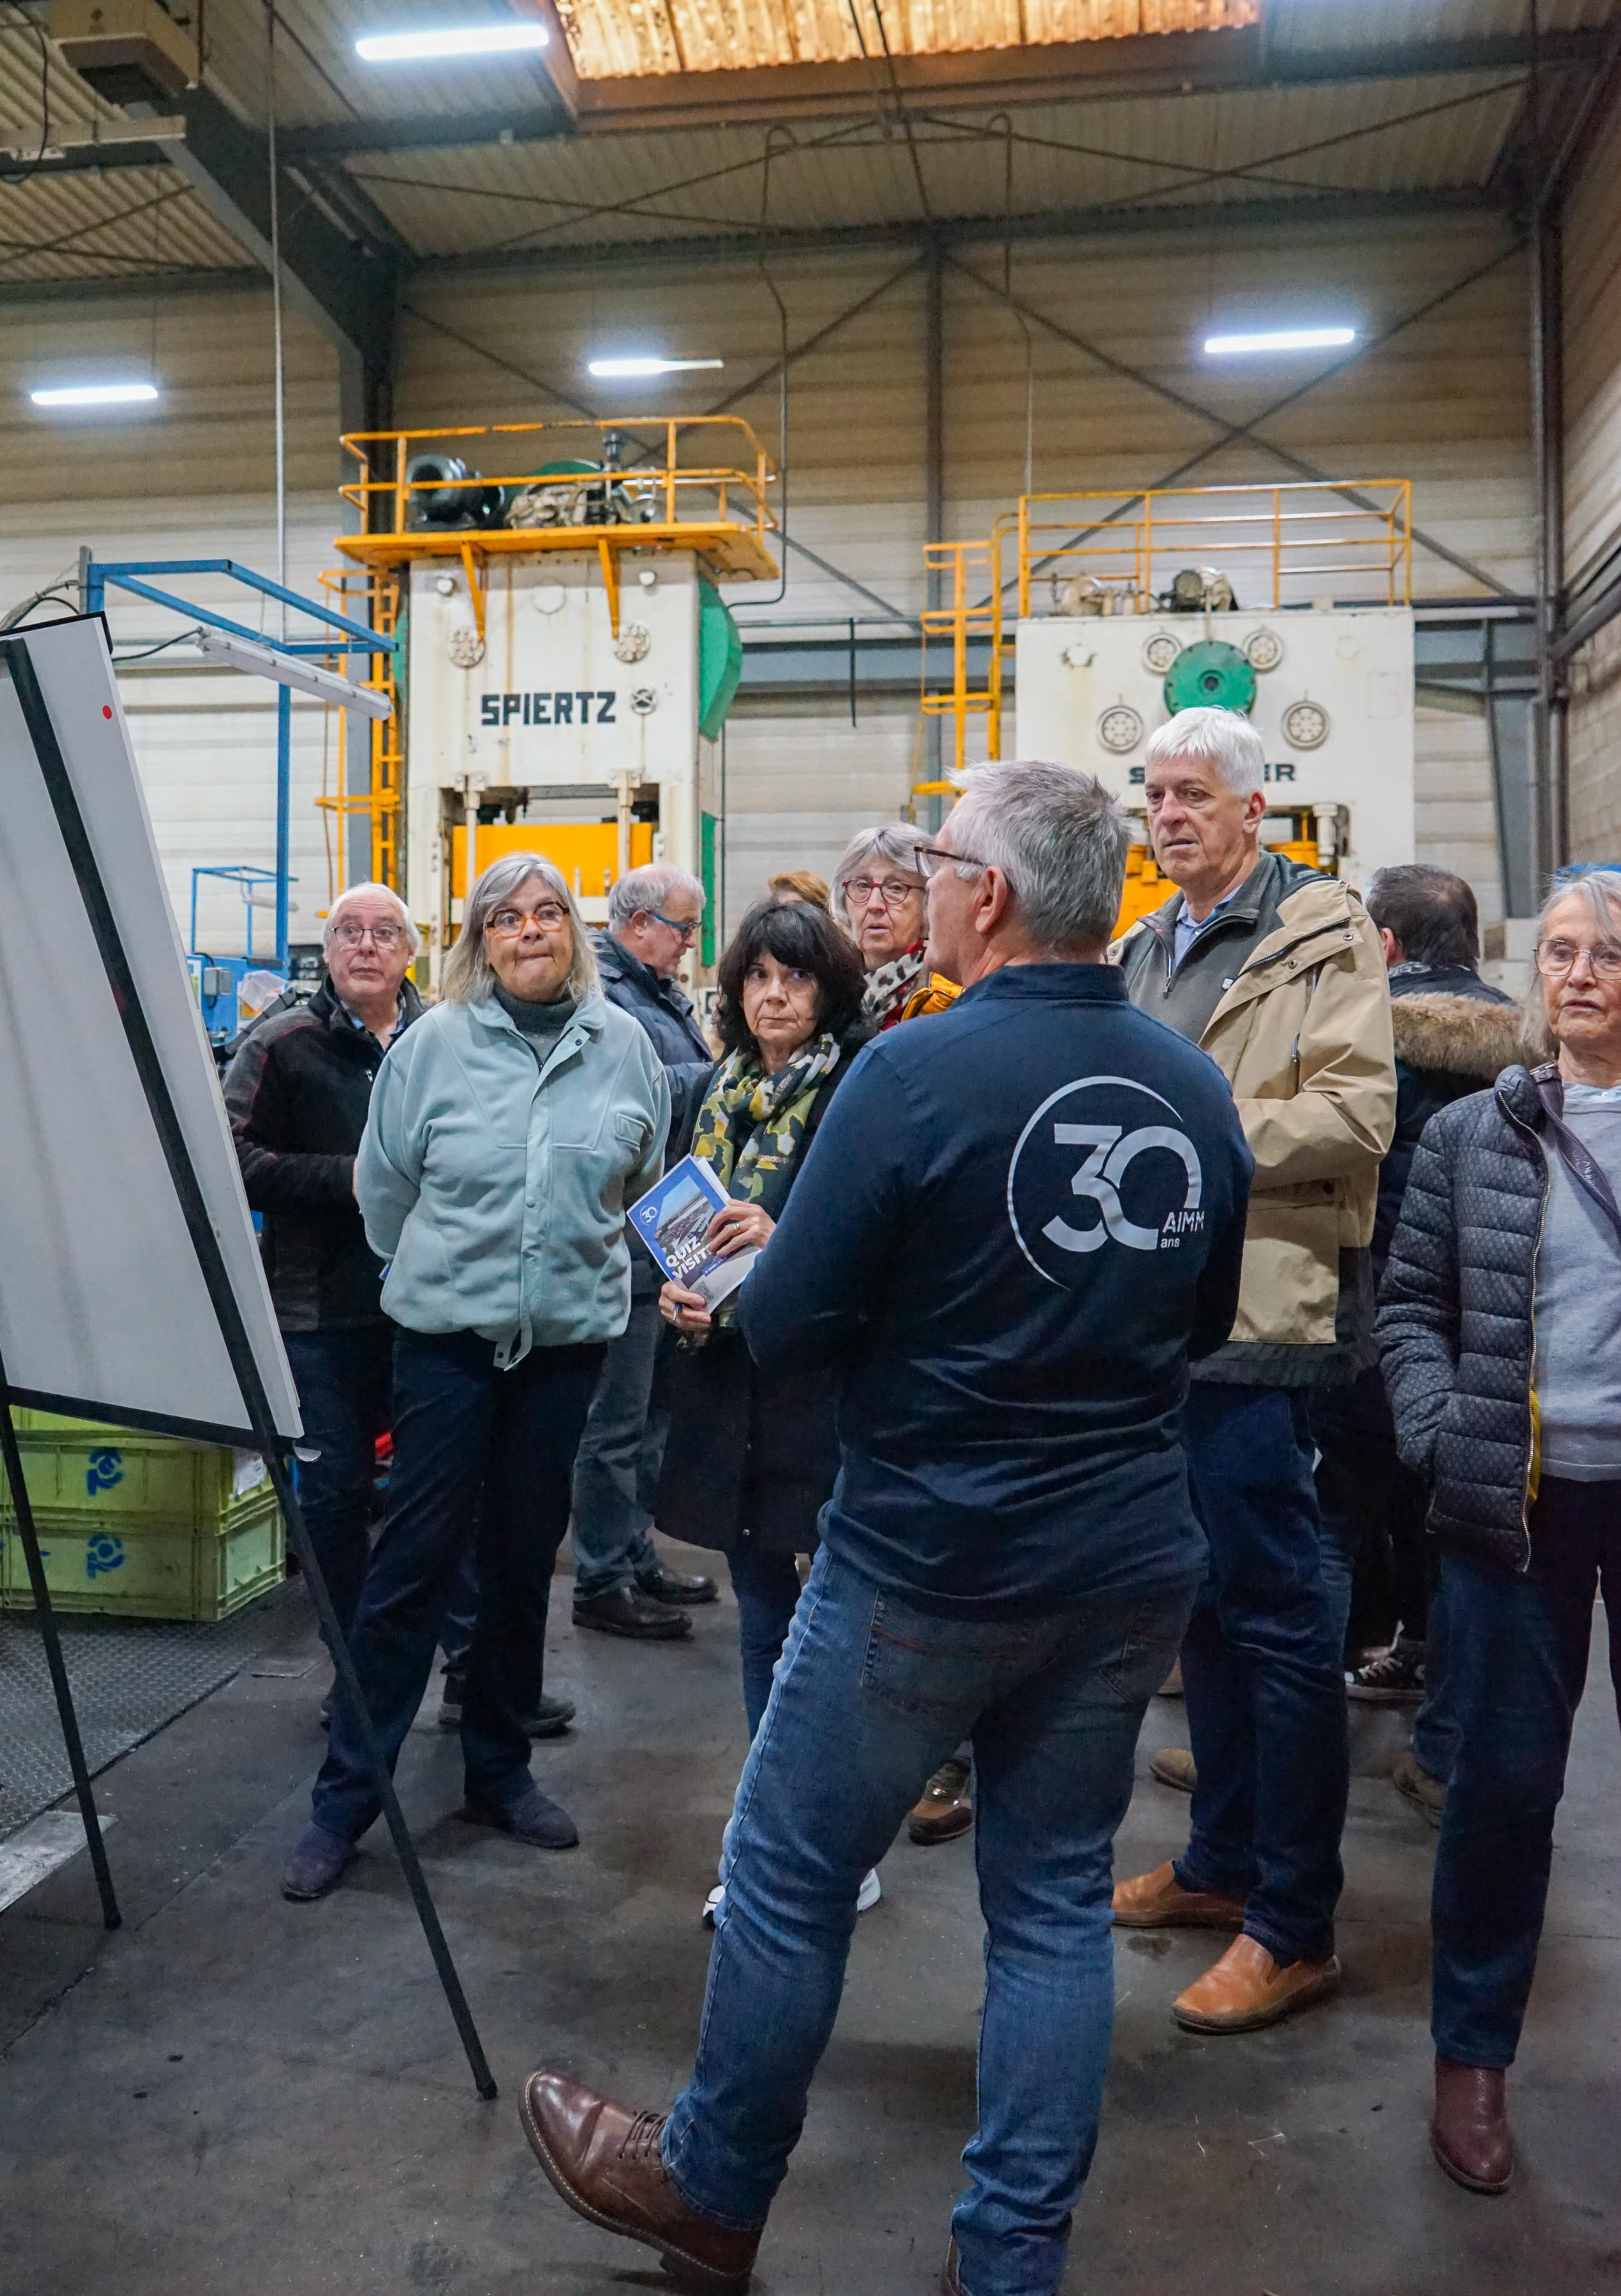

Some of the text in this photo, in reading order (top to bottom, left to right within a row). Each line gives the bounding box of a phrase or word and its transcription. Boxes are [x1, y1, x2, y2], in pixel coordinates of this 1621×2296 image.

[482, 692, 615, 725] SPIERTZ
[1042, 1123, 1202, 1252] 30
[1163, 1211, 1204, 1233] AIMM
[666, 1236, 701, 1267] QUIZ
[1160, 1238, 1180, 1248] ans
